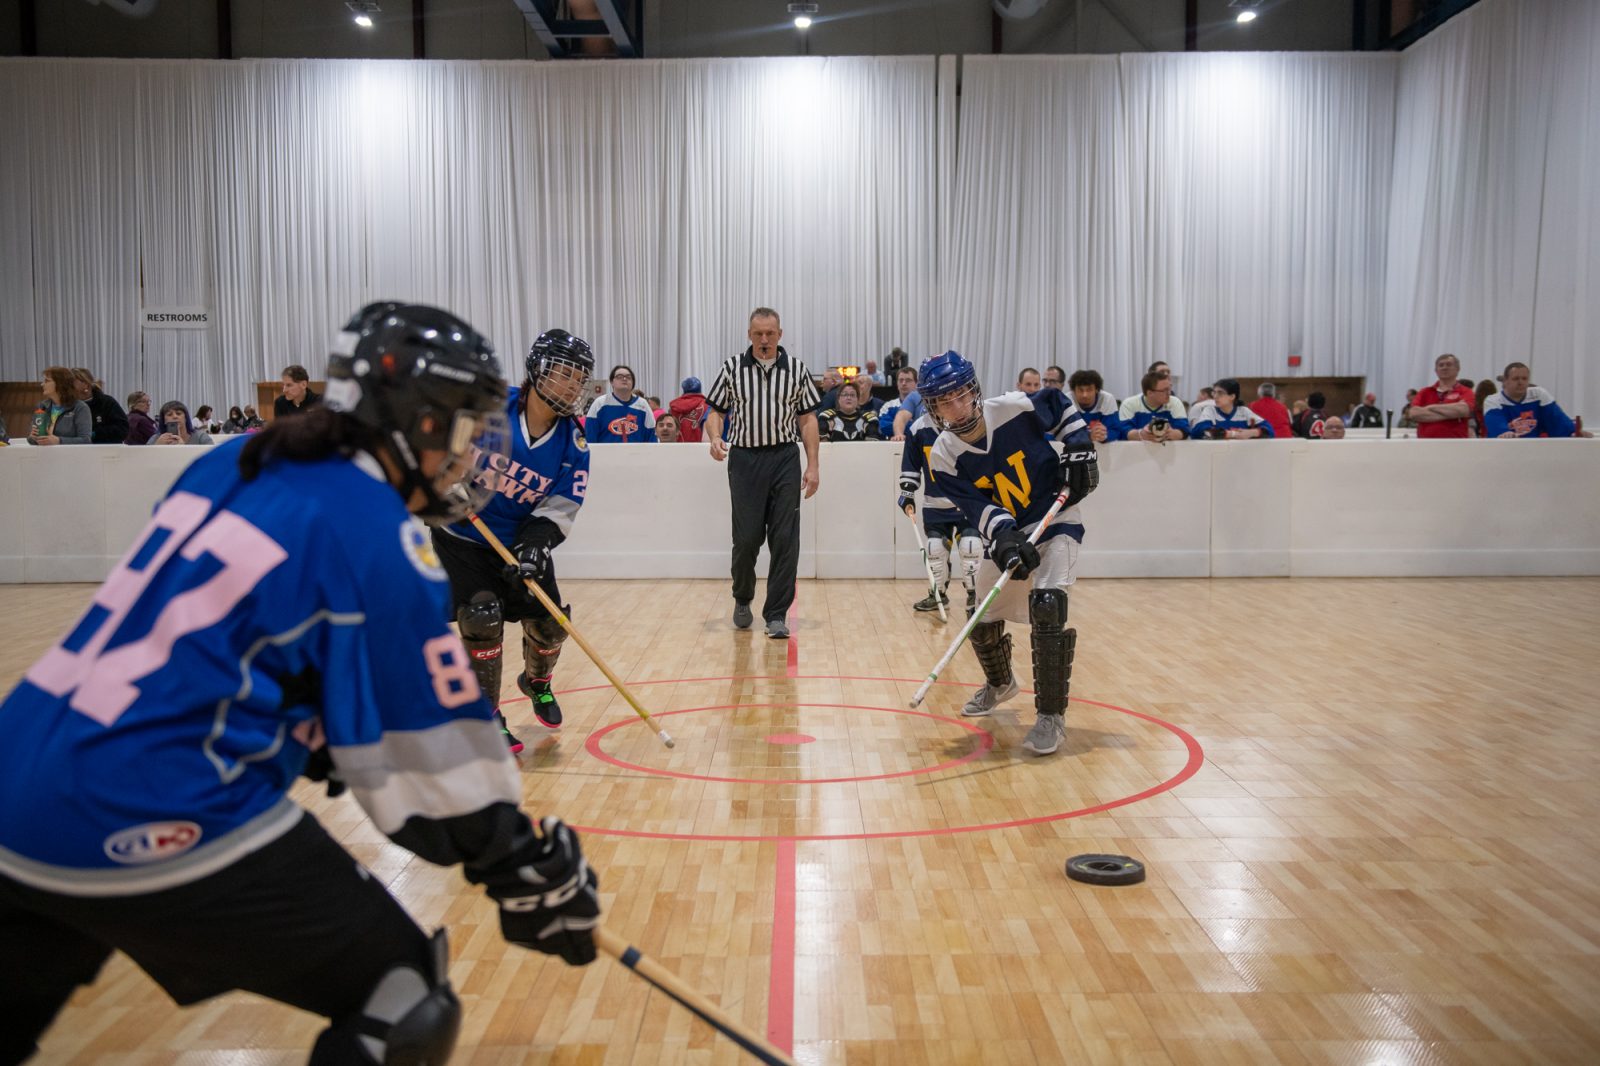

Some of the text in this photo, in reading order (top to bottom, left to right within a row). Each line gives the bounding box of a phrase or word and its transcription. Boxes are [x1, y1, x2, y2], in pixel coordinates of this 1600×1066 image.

[147, 313, 208, 323] RESTROOMS
[489, 453, 553, 493] CITY
[1060, 451, 1097, 464] CCM
[473, 467, 546, 506] AWK
[572, 470, 589, 498] 2
[25, 489, 290, 728] 87
[423, 635, 482, 708] 8
[501, 872, 584, 912] CC
